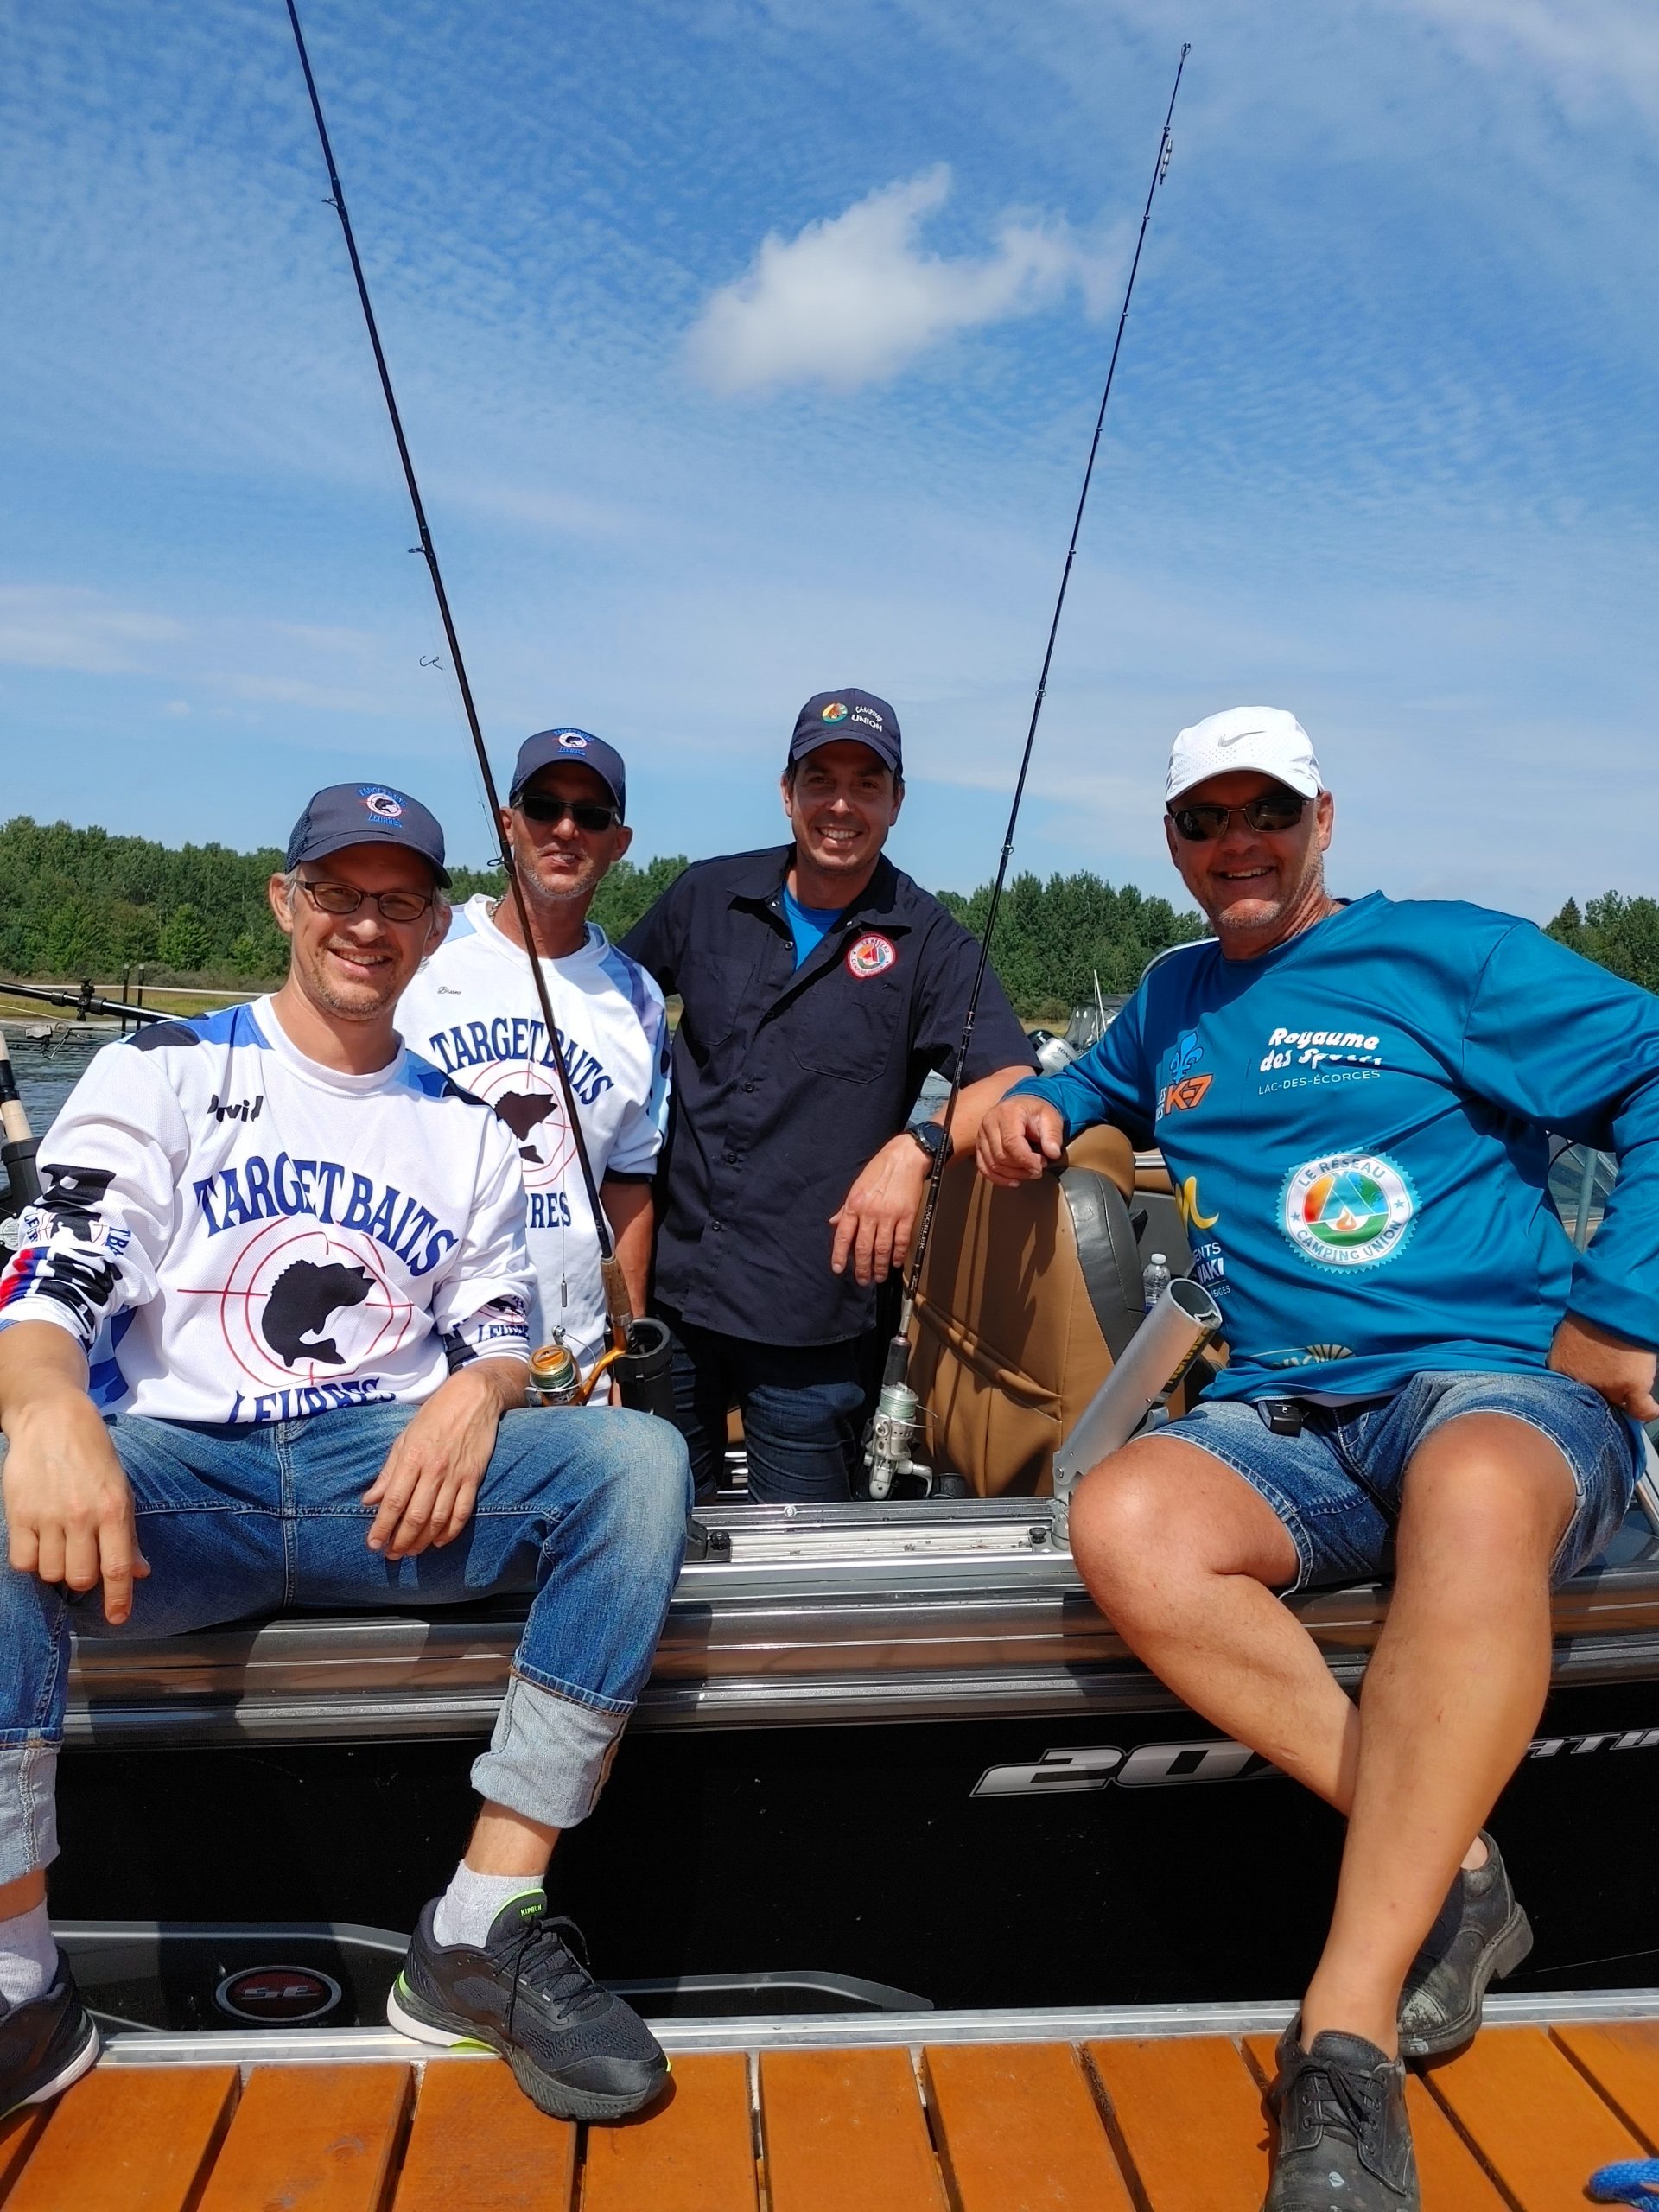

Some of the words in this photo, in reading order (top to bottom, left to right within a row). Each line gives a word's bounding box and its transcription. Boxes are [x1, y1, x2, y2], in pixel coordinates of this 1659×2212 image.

[851, 714, 883, 733] UNION
[1268, 1027, 1380, 1050] Royaume
[1260, 1049, 1293, 1071] des
[1258, 1070, 1381, 1095] LAC-DES-ÉCORCES
[1164, 1074, 1213, 1116] K-7
[1298, 1169, 1317, 1188] LE
[1319, 1158, 1386, 1179] RÉSEAU
[1193, 1242, 1222, 1262] ENTS
[1296, 1229, 1360, 1261] CAMPING
[1363, 1220, 1402, 1257] UNION
[969, 1737, 1289, 1797] 20
[241, 1986, 320, 2000] SE
